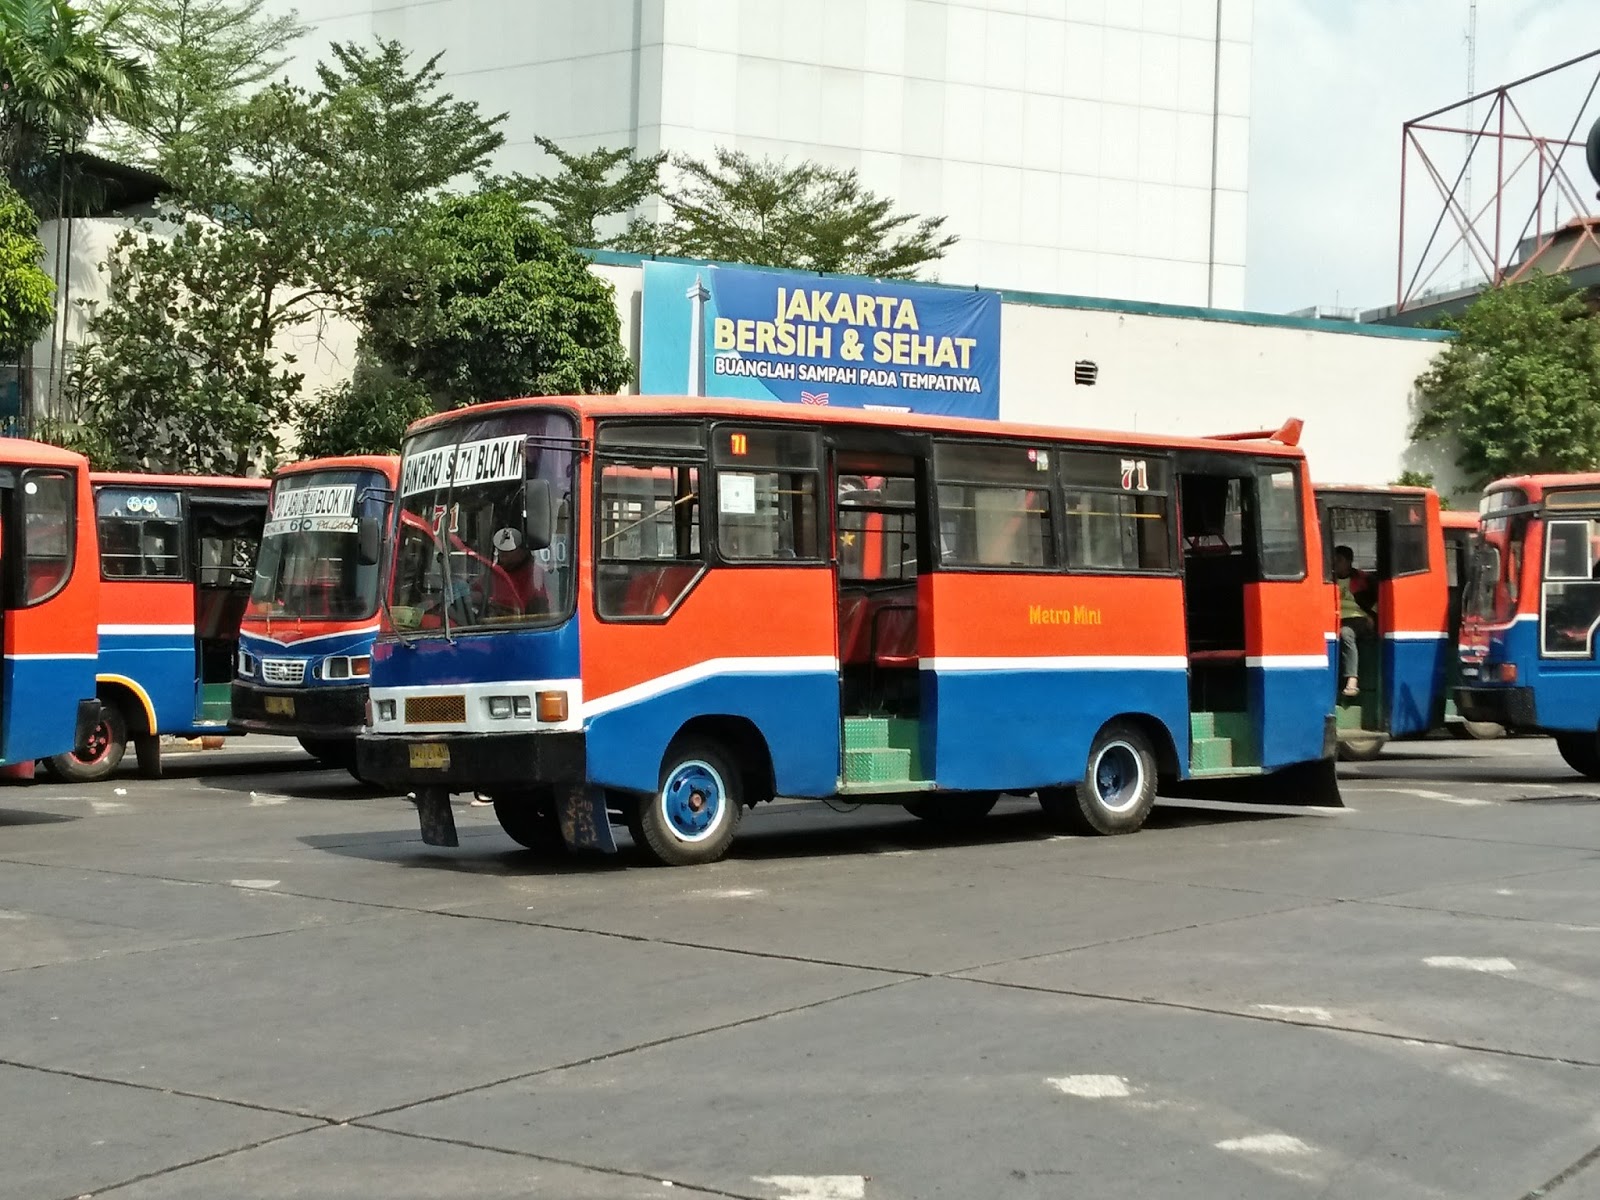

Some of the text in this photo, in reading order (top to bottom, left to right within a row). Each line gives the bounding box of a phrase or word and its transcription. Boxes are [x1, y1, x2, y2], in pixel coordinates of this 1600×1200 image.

[774, 287, 919, 330] JAKARTA
[714, 317, 977, 369] BERSIH & SEHAT
[715, 356, 982, 393] BUANGLAH SAMPAH PADA TEMPATNYA
[730, 433, 748, 456] 71
[403, 450, 443, 495] BINTARO
[474, 441, 509, 481] BLOK
[508, 440, 523, 477] M
[1120, 459, 1149, 491] 71
[315, 489, 341, 514] BLOK
[340, 488, 353, 514] M
[431, 501, 460, 536] 71
[1029, 605, 1102, 625] Metro Mini
